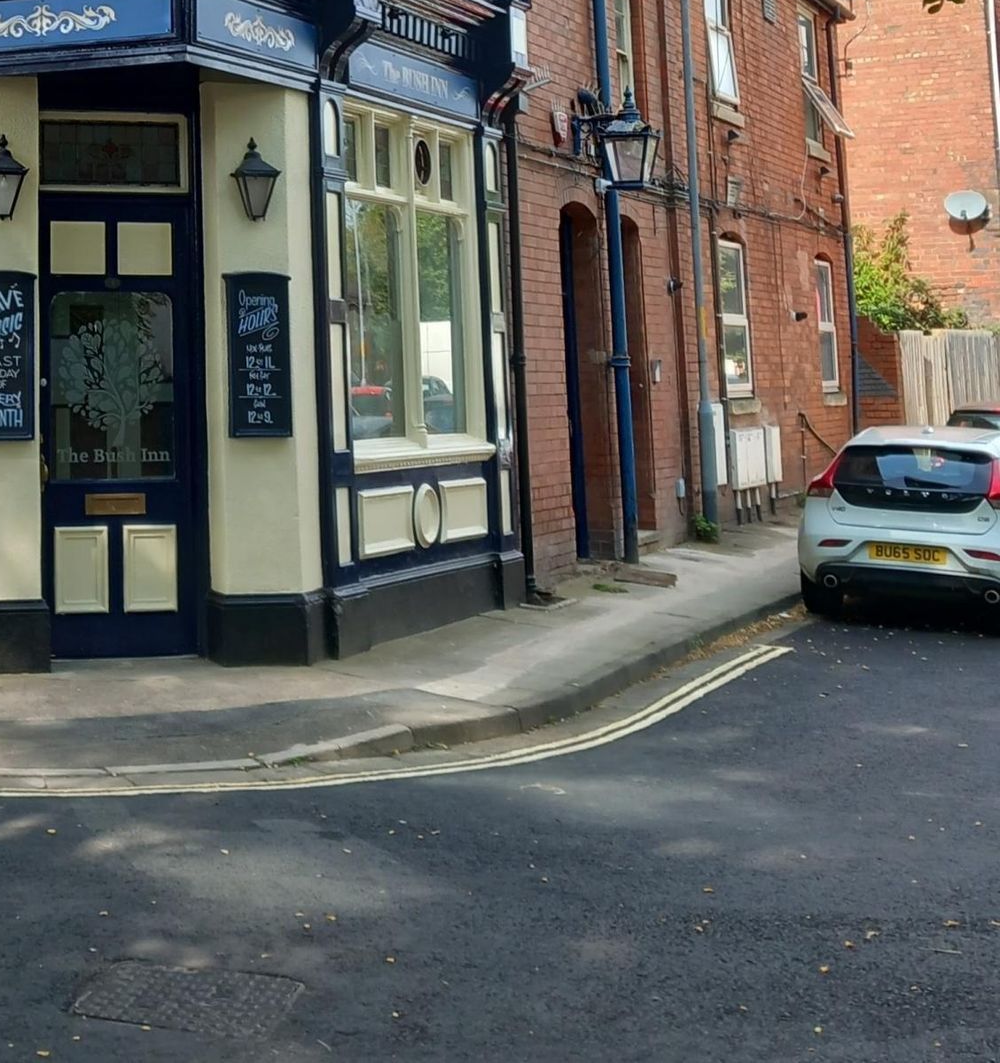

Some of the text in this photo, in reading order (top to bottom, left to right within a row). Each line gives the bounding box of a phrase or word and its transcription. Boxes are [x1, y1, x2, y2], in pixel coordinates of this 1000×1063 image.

[382, 60, 449, 99] The BUSH INN
[238, 289, 275, 309] Opening
[238, 304, 278, 334] HOURS
[57, 447, 171, 463] The Bush Inn
[876, 545, 941, 562] BU65 SOC
